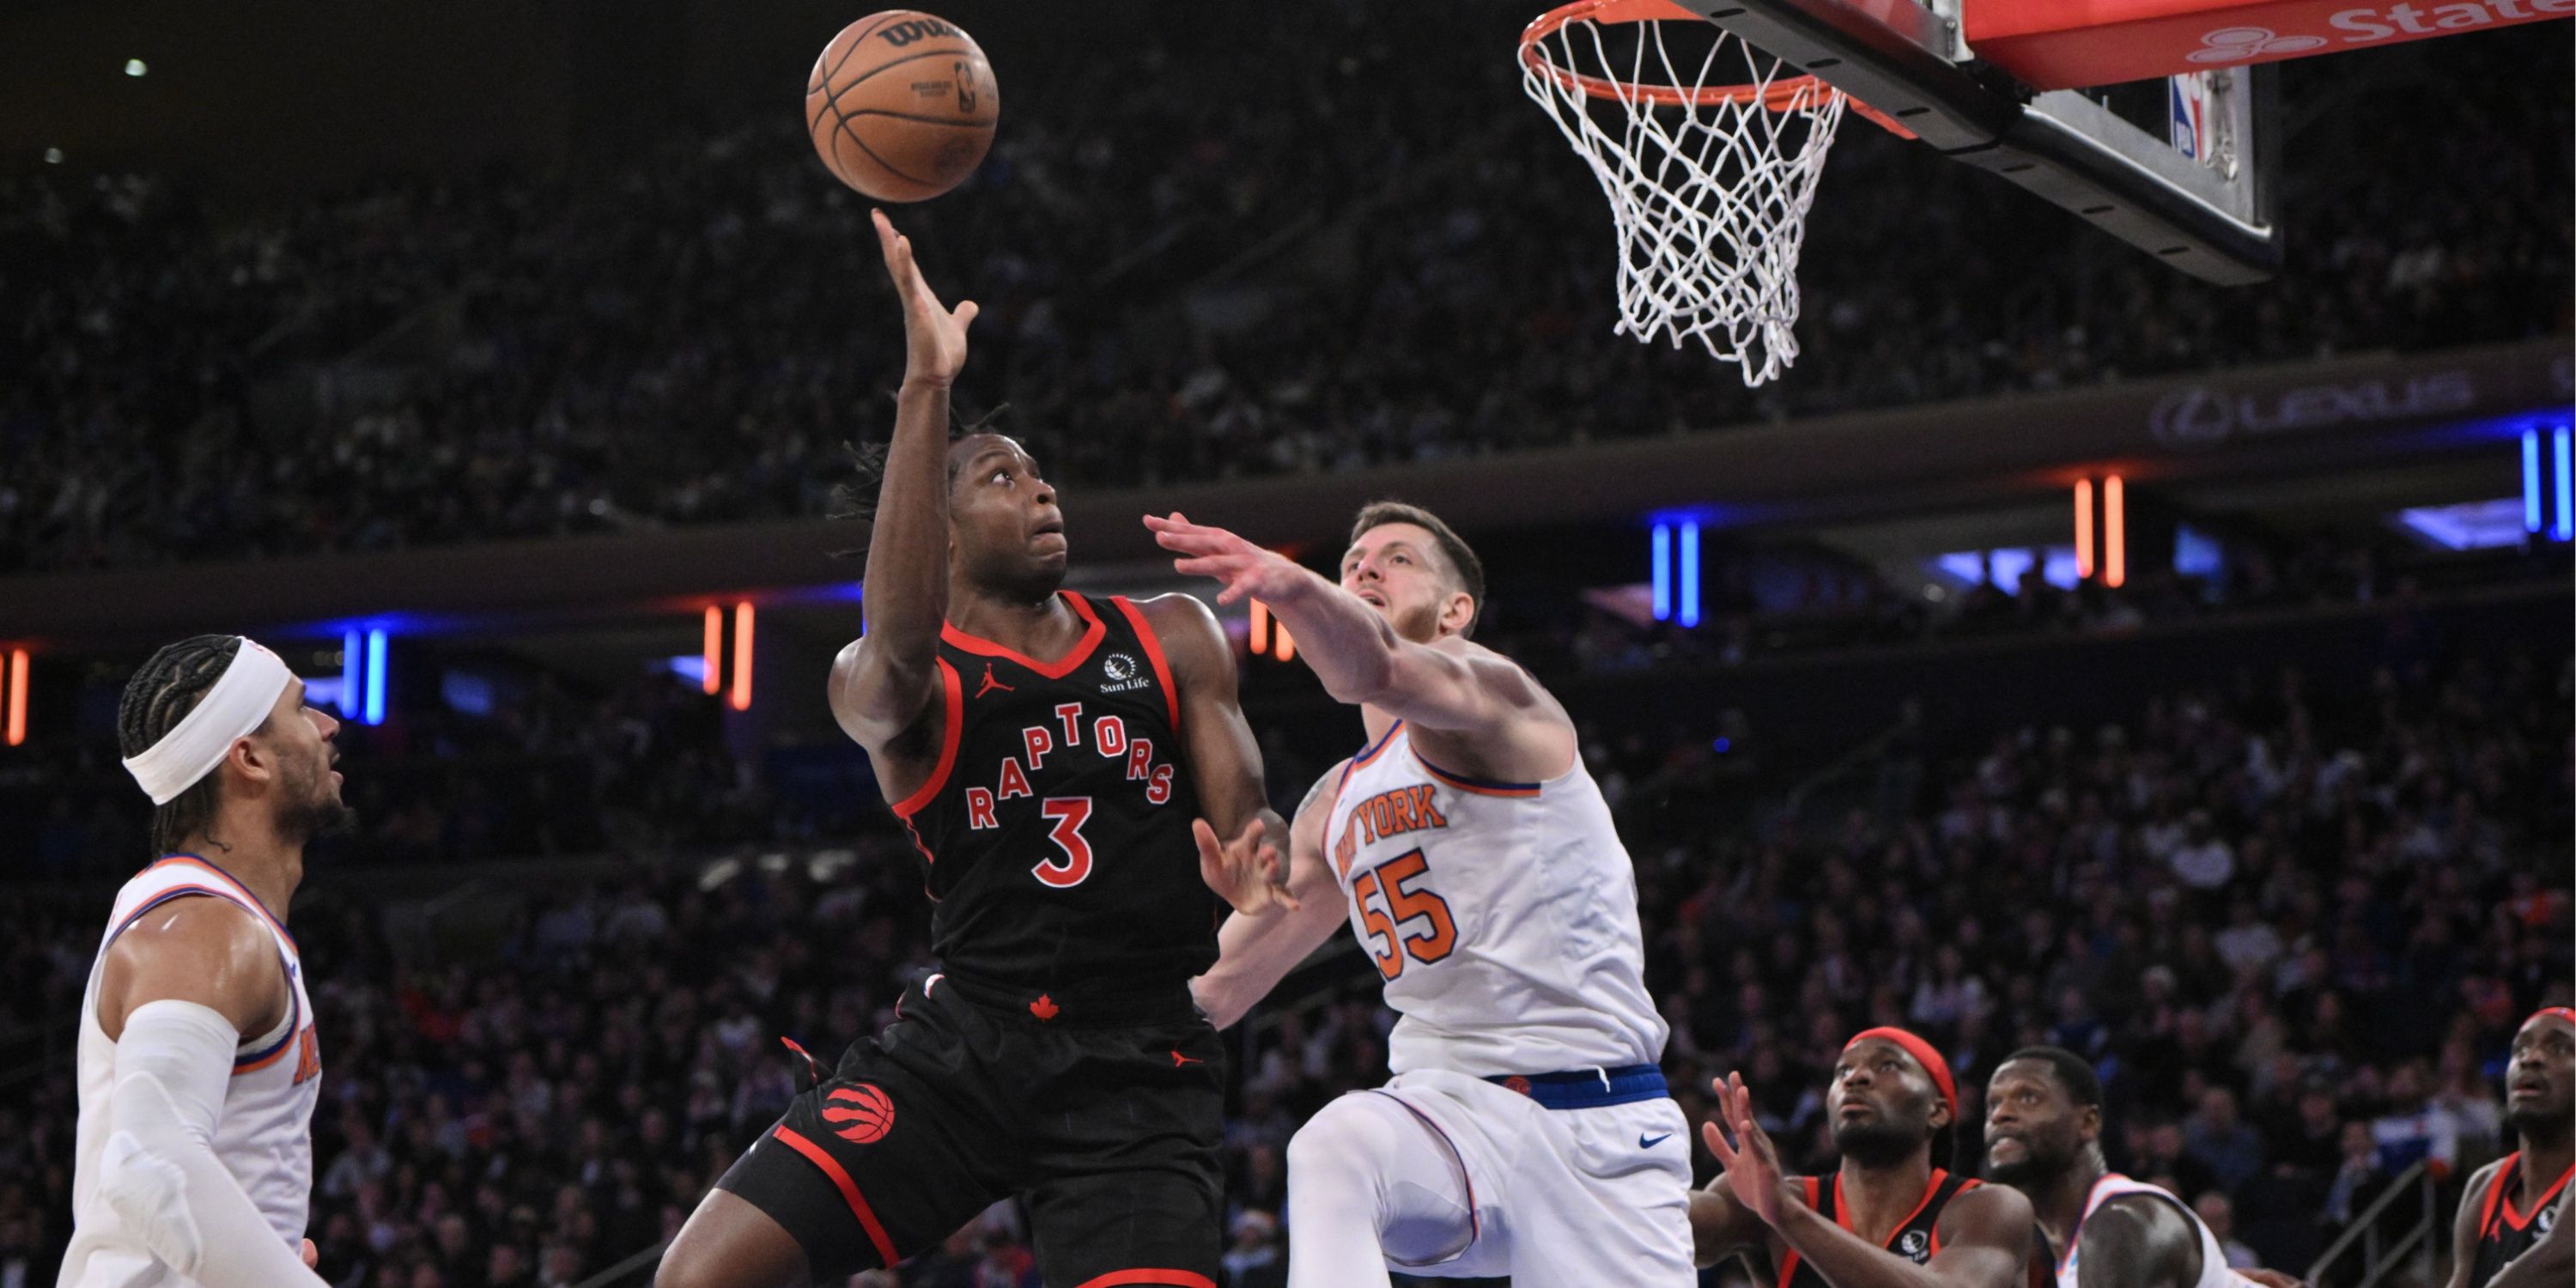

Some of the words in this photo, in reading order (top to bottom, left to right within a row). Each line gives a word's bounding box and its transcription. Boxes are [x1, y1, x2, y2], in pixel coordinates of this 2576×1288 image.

[1100, 683, 1125, 693] Sun
[1126, 677, 1150, 690] Life
[966, 702, 1174, 829] RAPTORS
[1031, 796, 1092, 888] 3
[1358, 783, 1448, 846] YORK
[1352, 847, 1458, 981] 55
